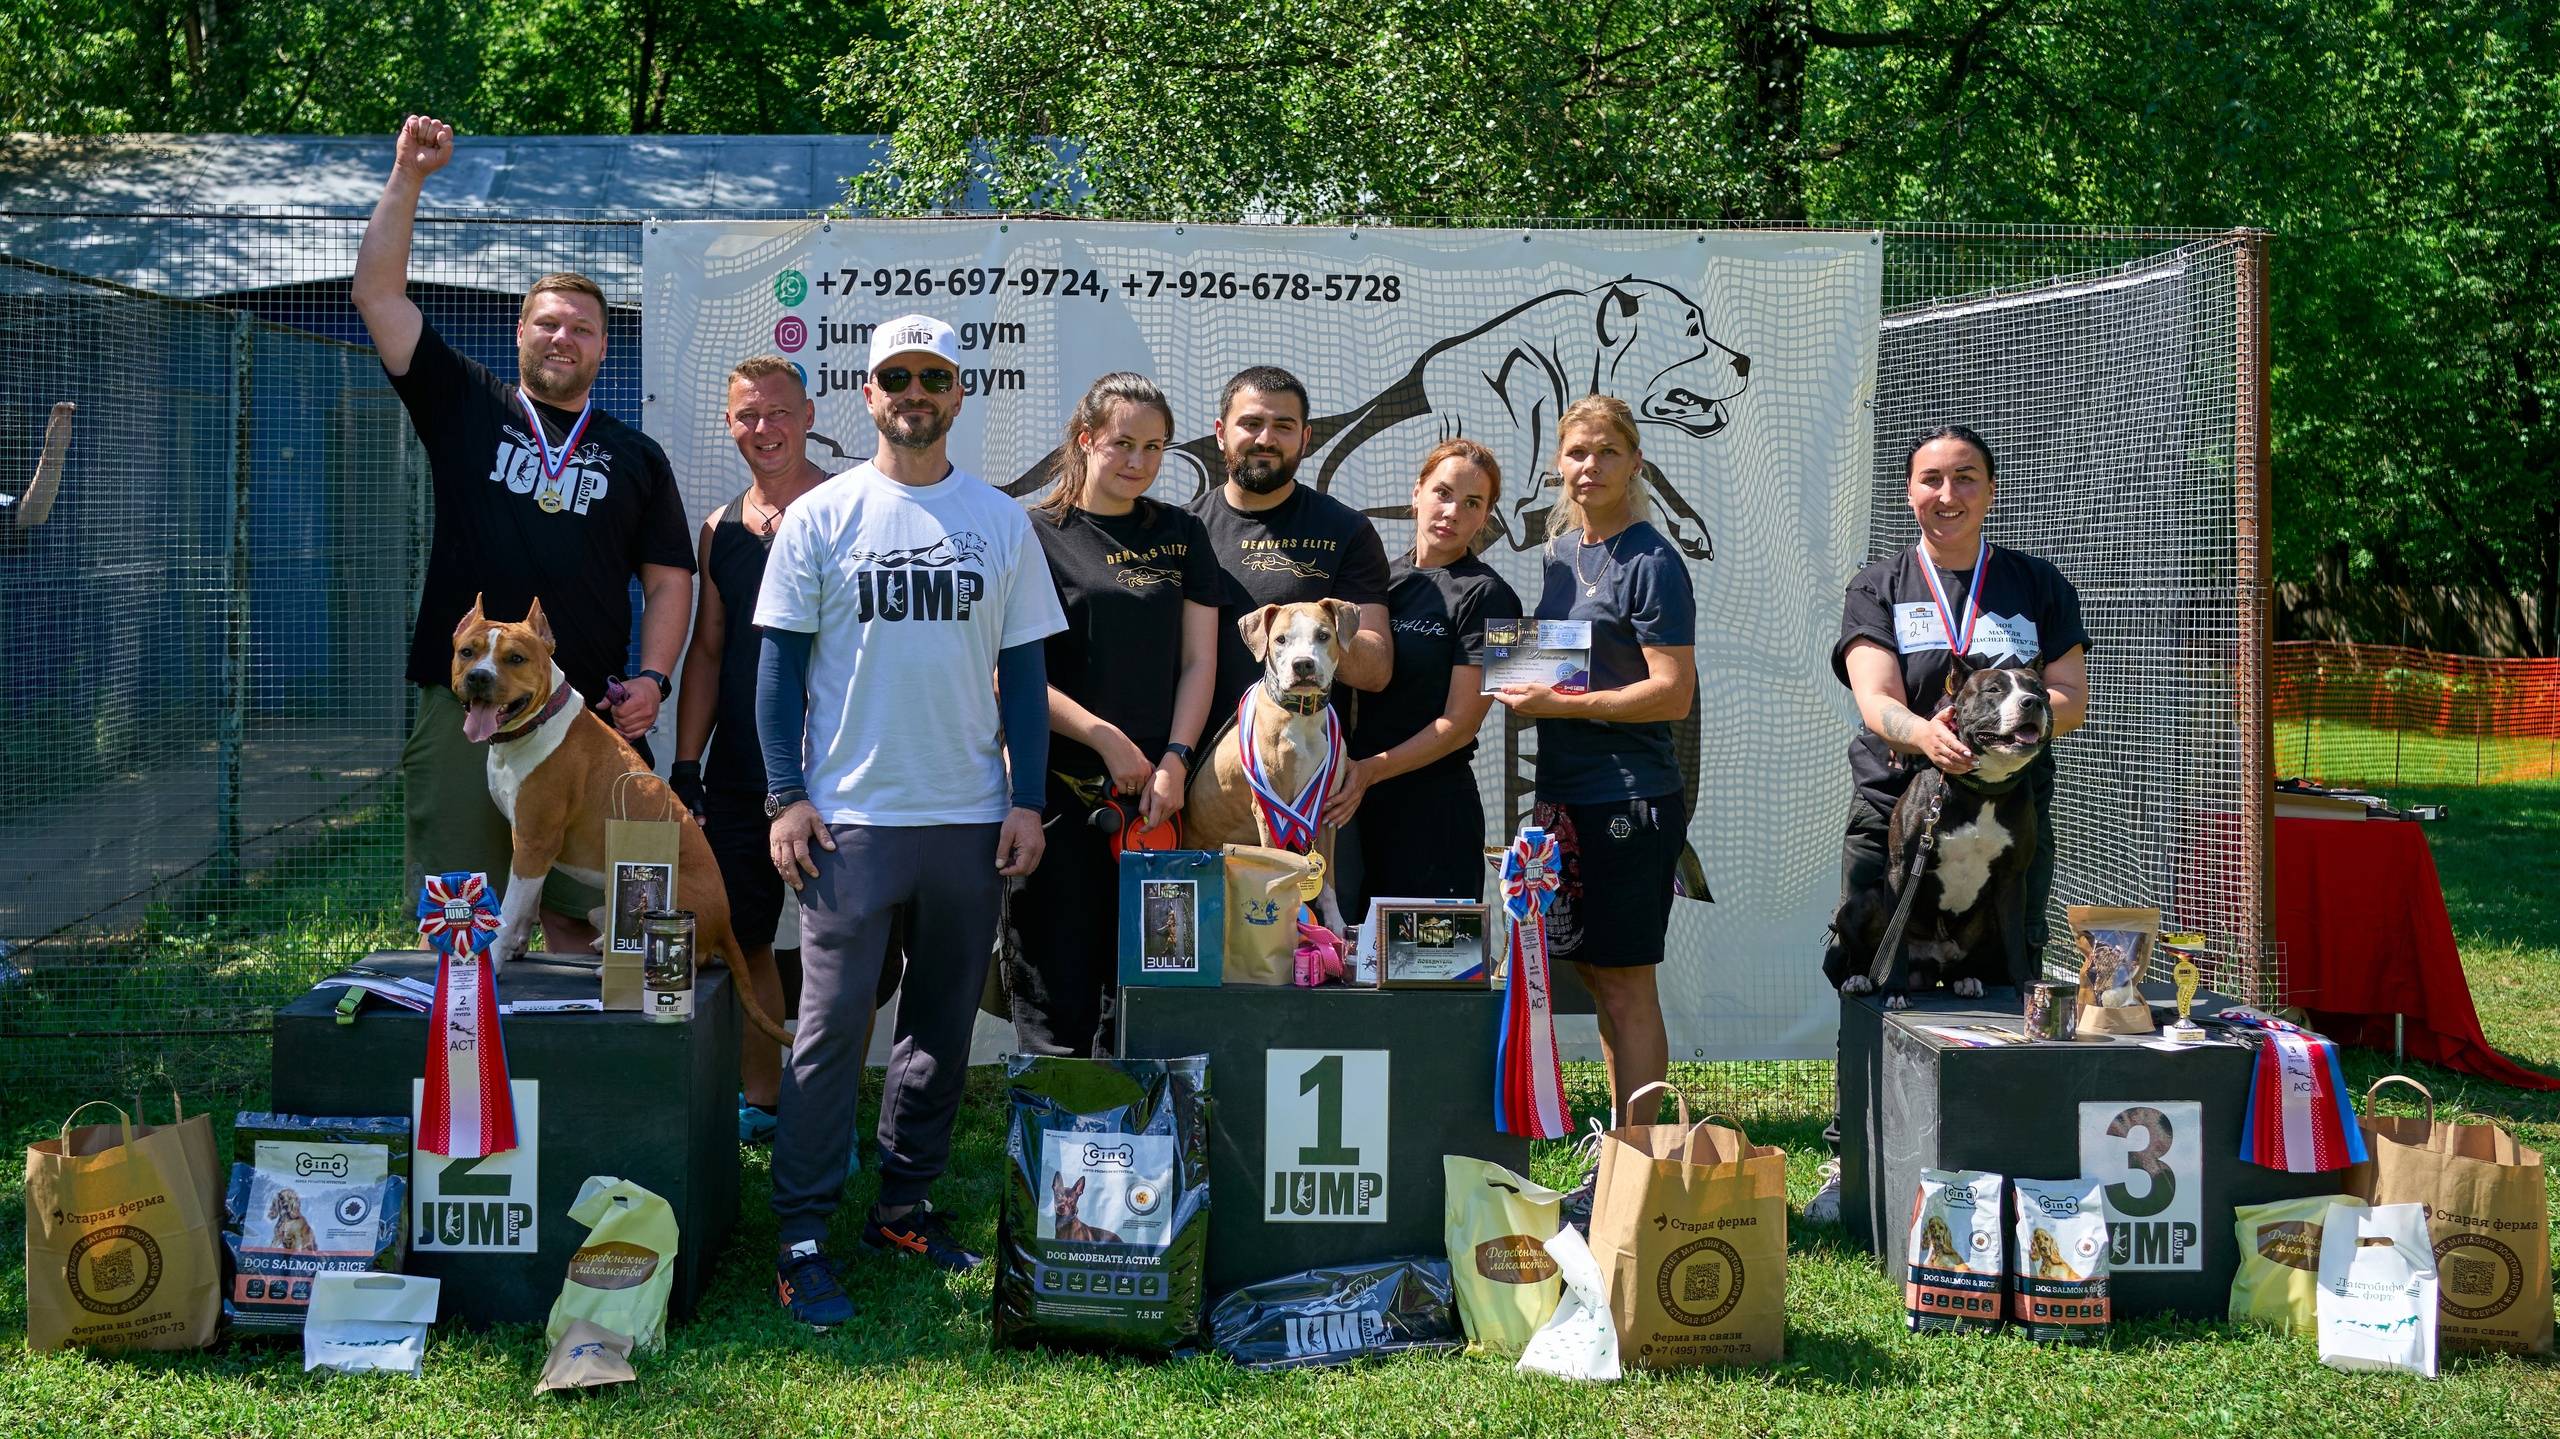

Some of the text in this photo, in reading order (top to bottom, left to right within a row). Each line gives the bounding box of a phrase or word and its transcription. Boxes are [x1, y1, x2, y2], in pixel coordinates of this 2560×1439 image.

[816, 268, 1401, 303] +7-926-697-9724, +7-926-678-5728
[889, 331, 933, 349] JUMP
[489, 441, 609, 516] JUMP
[1241, 538, 1337, 552] DENVERS ELITE
[857, 570, 984, 623] JUMP
[445, 908, 470, 919] JUMP
[460, 996, 466, 1005] 2
[1299, 1055, 1360, 1165] 1
[1089, 1149, 1127, 1160] Gina
[2104, 1106, 2176, 1217] 3
[303, 1160, 340, 1170] Gina
[1270, 1172, 1383, 1216] JUMP
[1948, 1187, 1973, 1200] Gina
[67, 1193, 166, 1225] Старая ферма
[2043, 1200, 2073, 1210] Gina
[418, 1202, 533, 1246] JUMP
[1671, 1216, 1757, 1233] Старая ферма
[2436, 1209, 2538, 1232] Старая ферма
[2105, 1222, 2197, 1265] UMP
[82, 1227, 127, 1248] МАГАЗИН
[127, 1229, 161, 1278] ЗООТОВАРОВ
[572, 1250, 649, 1265] Деревенские
[1046, 1250, 1161, 1266] DOG MODERATE ACTIVE
[244, 1258, 366, 1272] DOG SALMON & RICE
[575, 1264, 643, 1277] лакомства
[1490, 1257, 1550, 1271] лакомства
[1659, 1239, 1742, 1300] ИНТЕРНЕТ МАГАЗИН ЗООТОВАРОВ
[2448, 1236, 2521, 1297] МАГАЗИН ЗООТОВАРОВ
[1923, 1273, 1940, 1282] DOG
[1940, 1275, 1972, 1286] SALMON
[2035, 1284, 2052, 1293] DOG
[2052, 1286, 2084, 1294] SALMON
[82, 1287, 151, 1314] СТАРАЯ ФЕРМА
[1669, 1304, 1731, 1325] СТАРАЯ ФЕРМА
[2471, 1302, 2509, 1318] ФЕРМА
[72, 1311, 172, 1336] Ферма на связи
[96, 1331, 126, 1346] (495)
[128, 1321, 185, 1341] 790-70-73
[1284, 1310, 1384, 1357] JUMP
[1652, 1331, 1743, 1344] Ферма на связи
[2481, 1328, 2520, 1338] связи
[1656, 1344, 1752, 1357] +7 (495) 790-70-73
